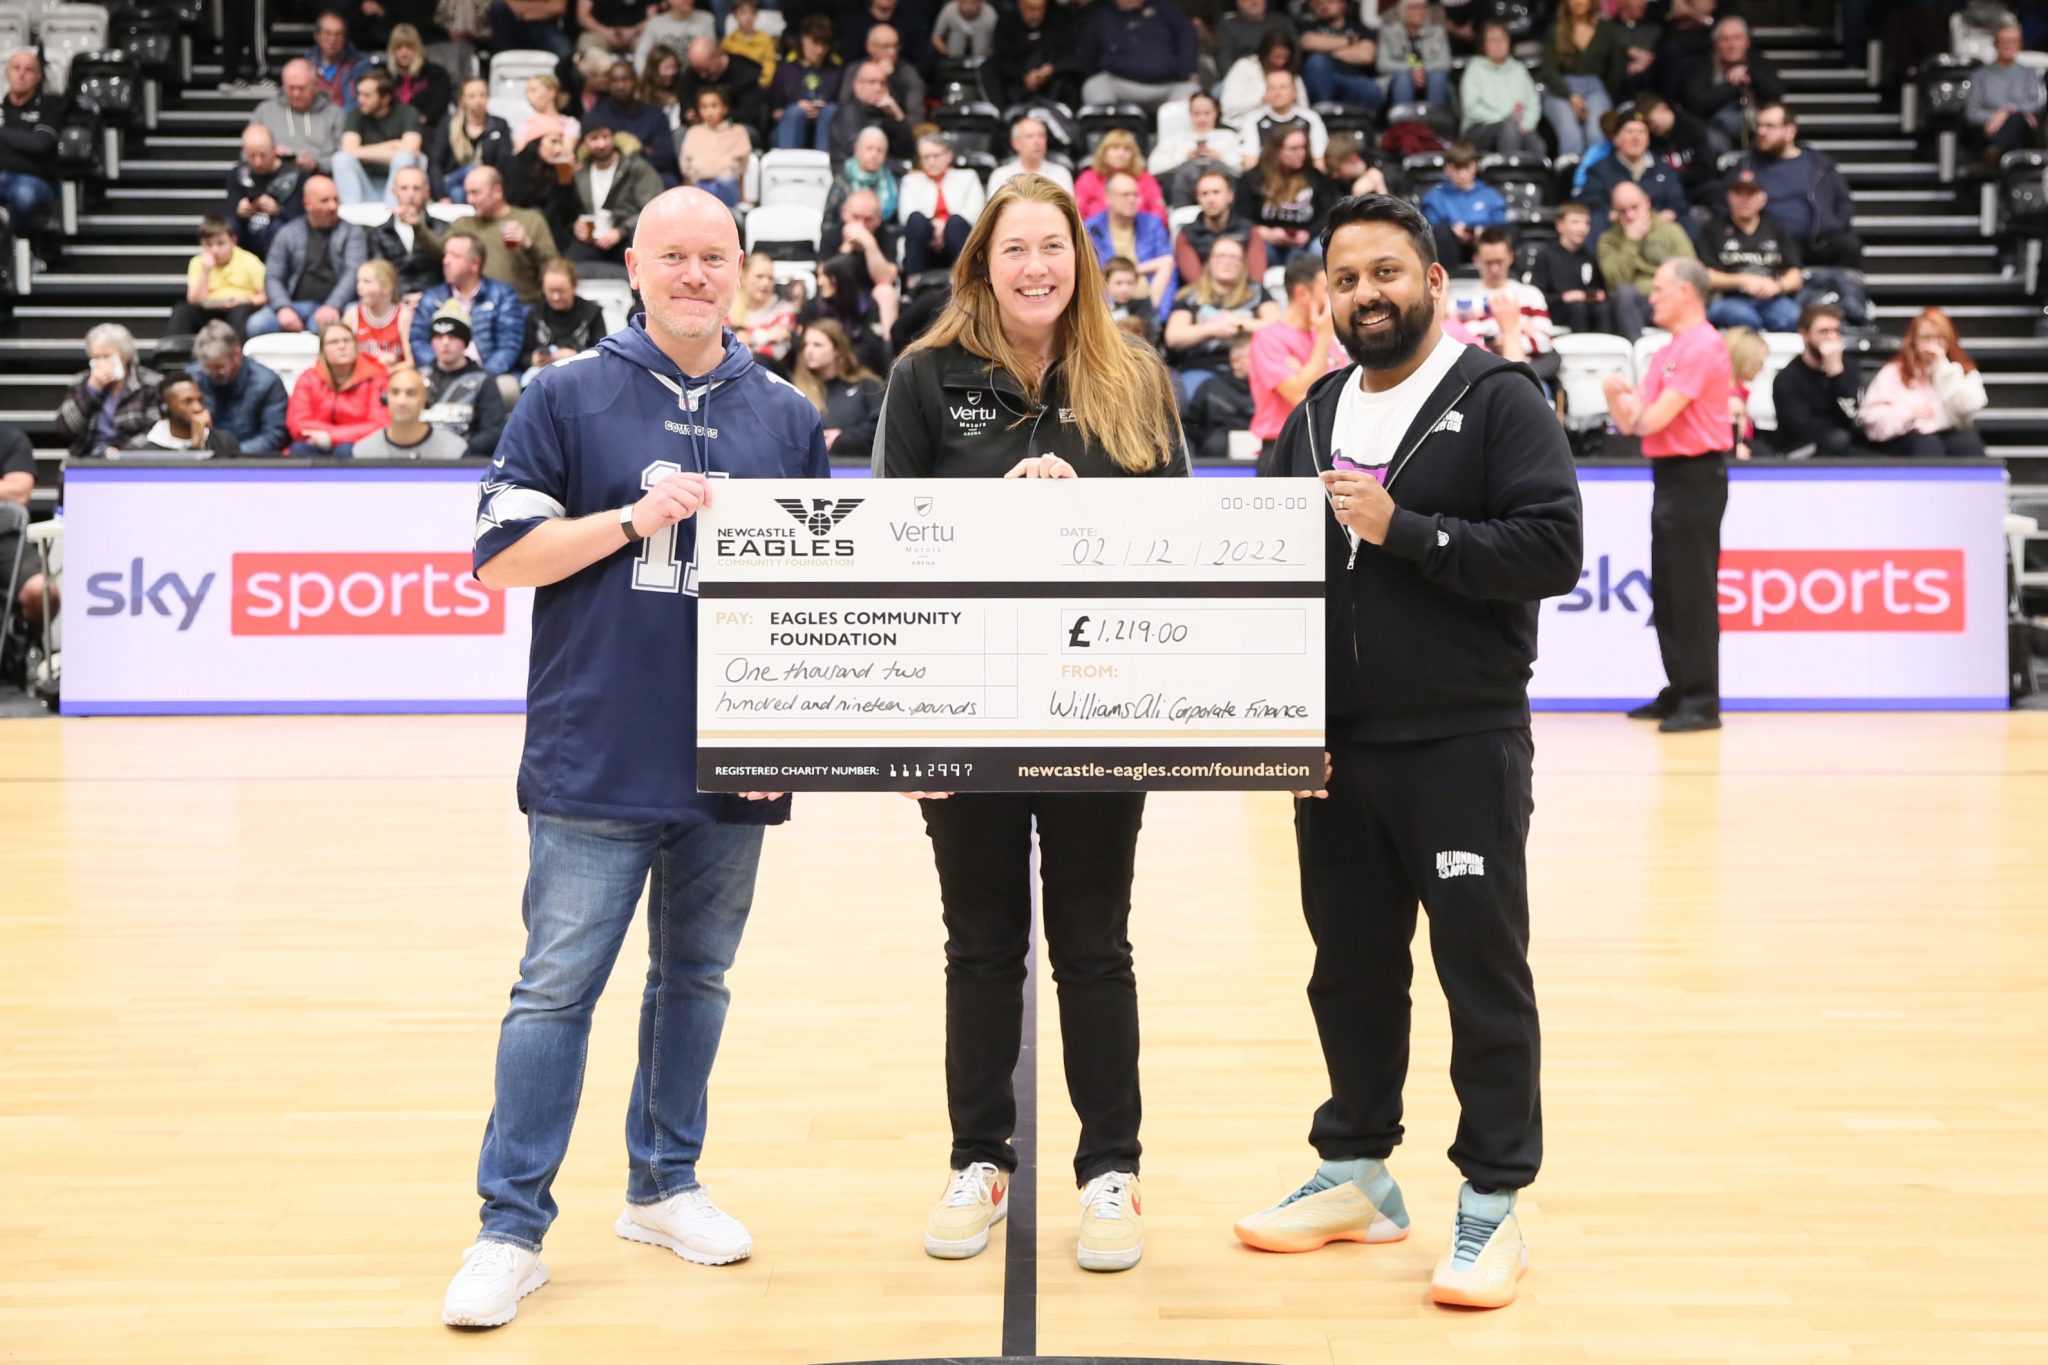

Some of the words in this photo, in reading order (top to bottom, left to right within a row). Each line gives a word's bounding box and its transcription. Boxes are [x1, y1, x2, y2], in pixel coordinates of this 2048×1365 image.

[949, 406, 997, 421] Vertu
[959, 421, 987, 429] Motors
[1221, 496, 1307, 510] 00-00-00
[717, 528, 796, 538] NEWCASTLE
[889, 521, 954, 542] Vertu
[1060, 527, 1098, 538] DATE:
[717, 539, 855, 557] EAGLES
[1072, 537, 1105, 566] 02
[1145, 539, 1173, 563] 12
[1212, 539, 1288, 566] 2022
[717, 559, 782, 567] COMMUNITY
[785, 559, 855, 567] FOUNDATION
[86, 557, 216, 631] sky
[245, 563, 490, 631] sports
[1716, 560, 1951, 627] sports
[715, 611, 753, 625] PAY:
[770, 611, 838, 625] EAGLES
[844, 611, 962, 625] COMMUNITY
[770, 633, 897, 646] FOUNDATION
[725, 657, 779, 683] One
[783, 659, 875, 681] thousand
[882, 660, 927, 681] two
[1061, 664, 1118, 678] FROM:
[715, 691, 799, 713] hundred
[715, 766, 779, 776] REGISTERED
[781, 766, 829, 776] CHARITY
[831, 766, 880, 776] NUMBER:
[889, 763, 973, 778] 1112997
[1018, 762, 1310, 781] newcastle-eagles.com/foundation
